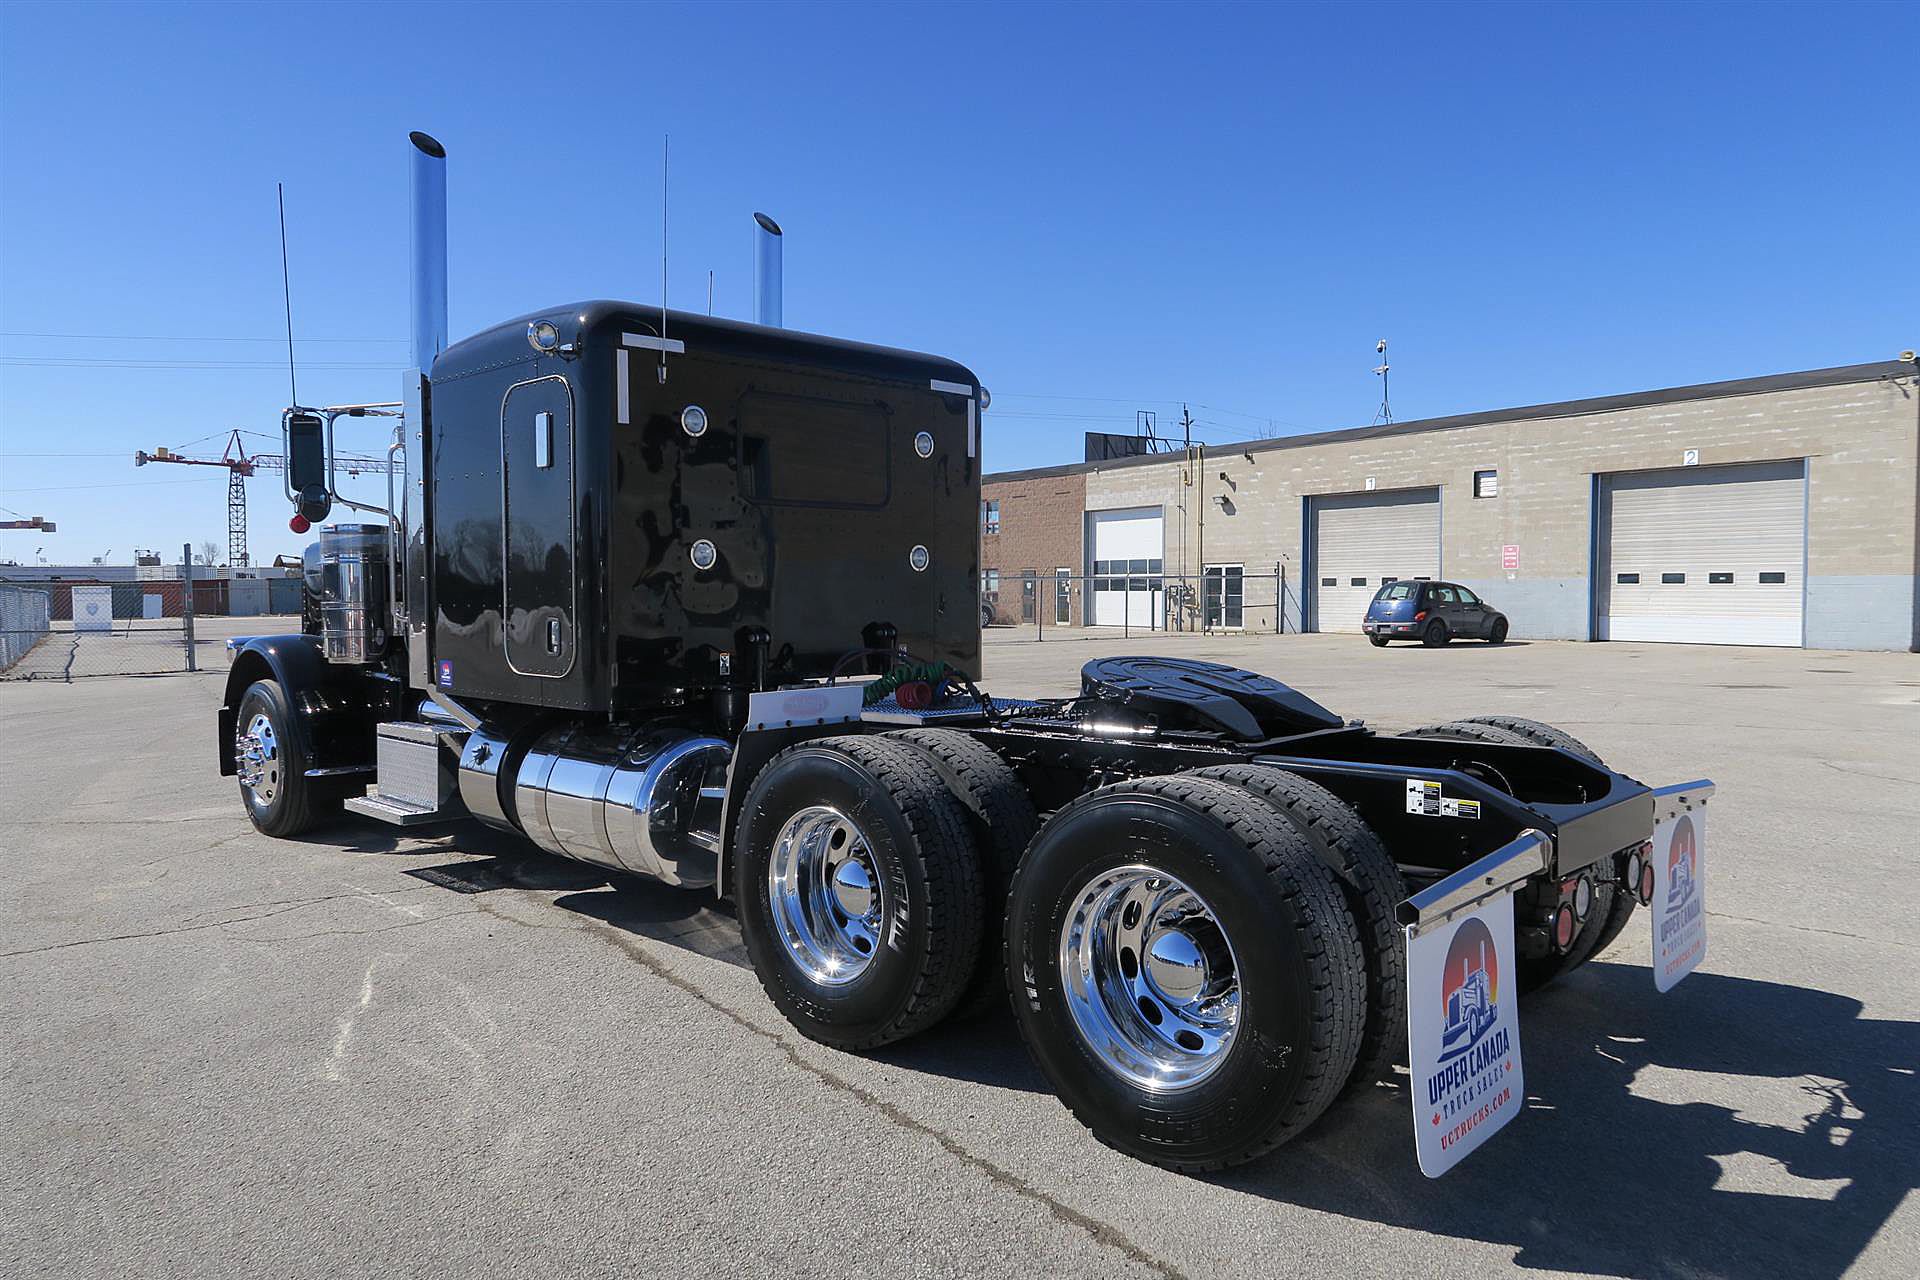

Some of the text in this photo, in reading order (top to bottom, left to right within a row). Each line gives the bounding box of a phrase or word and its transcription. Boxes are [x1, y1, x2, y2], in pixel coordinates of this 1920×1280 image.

[1686, 451, 1697, 464] 2
[1428, 1027, 1510, 1105] UPPER CANADA
[1443, 1064, 1503, 1120] TRUCK SALES
[1440, 1087, 1511, 1151] UCTRUCKS.COM
